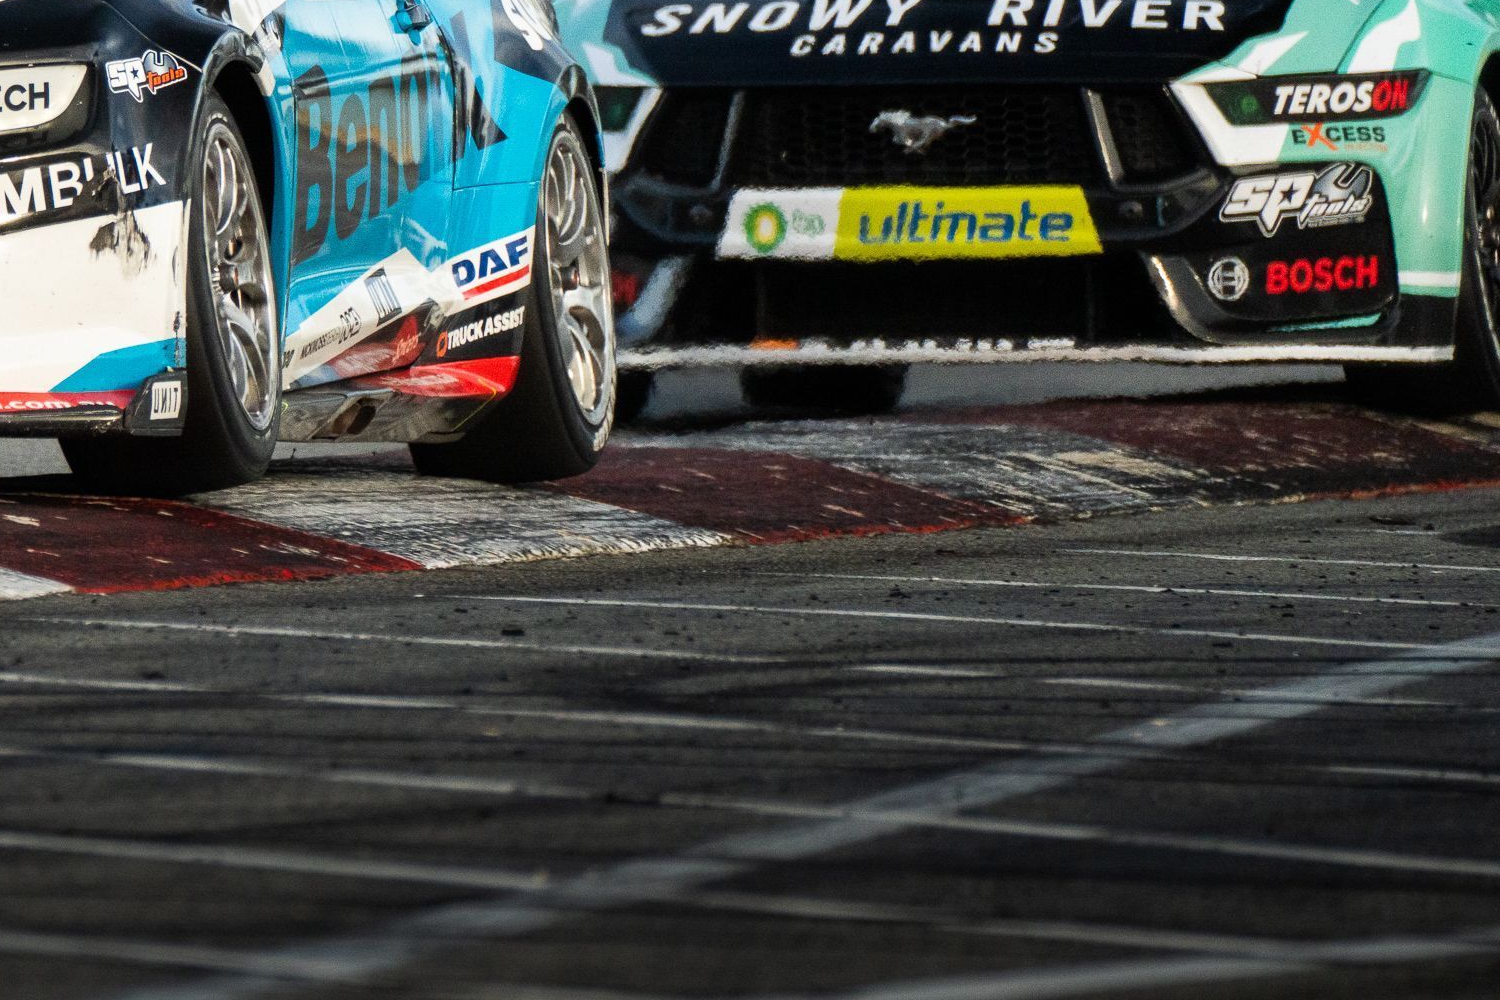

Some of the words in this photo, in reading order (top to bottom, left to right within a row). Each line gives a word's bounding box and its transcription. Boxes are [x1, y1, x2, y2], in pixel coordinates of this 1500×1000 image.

[789, 29, 1060, 57] CARAVANS
[1274, 80, 1409, 116] TEROSON
[1292, 122, 1386, 151] EXCESS
[858, 200, 1074, 244] ultimate
[452, 235, 529, 288] DAF
[1265, 255, 1379, 295] BOSCH
[153, 387, 179, 413] UNIT
